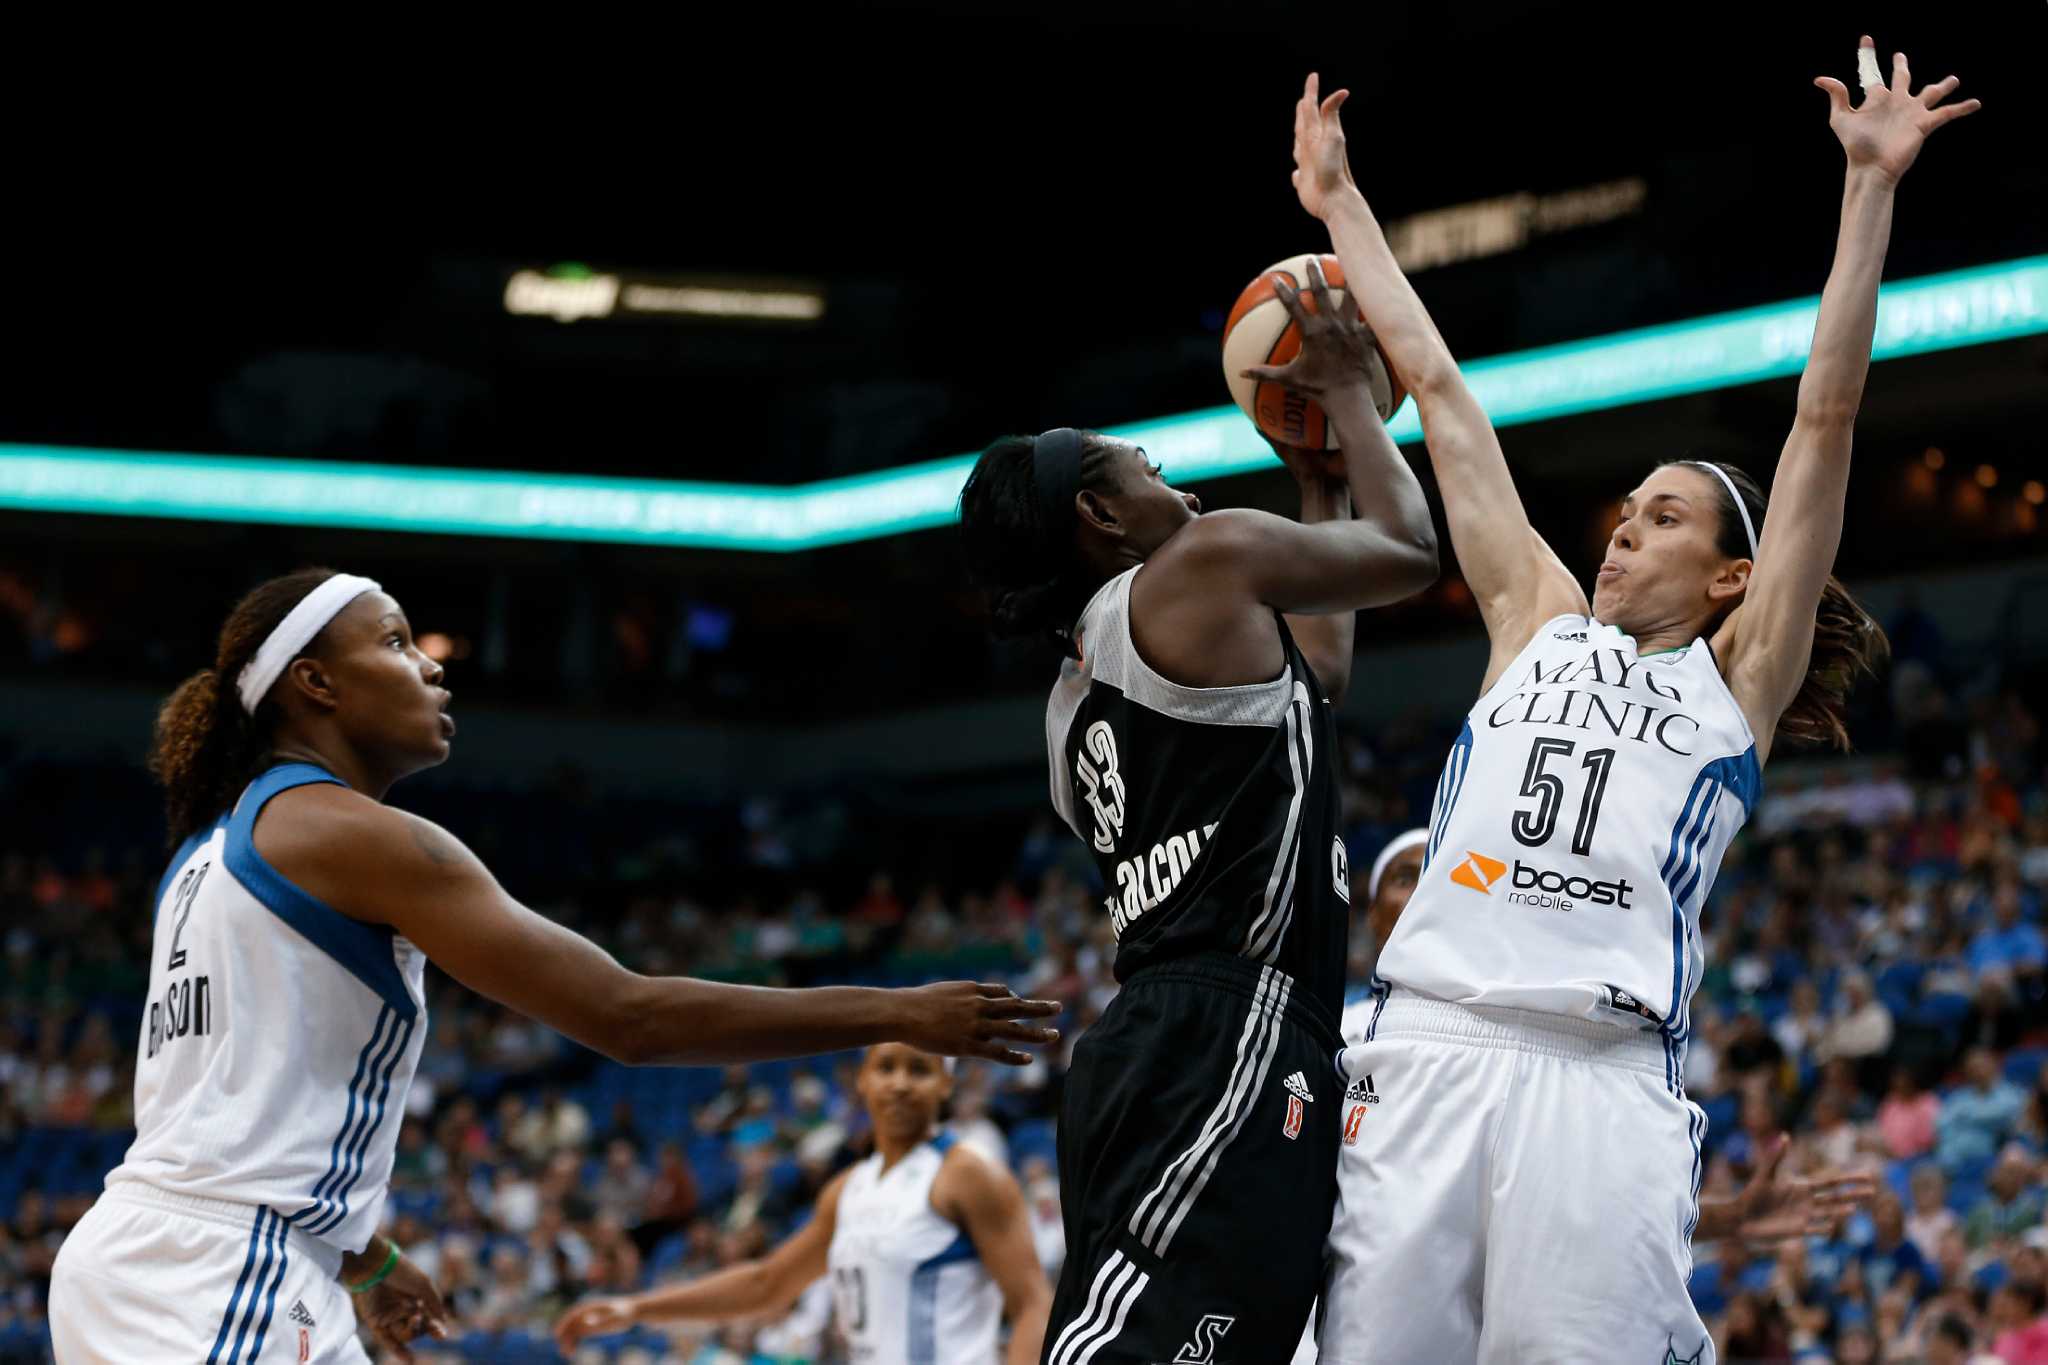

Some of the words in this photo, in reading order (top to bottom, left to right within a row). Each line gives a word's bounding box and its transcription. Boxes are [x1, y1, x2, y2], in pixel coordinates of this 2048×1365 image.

[1488, 690, 1700, 756] CLINIC
[1077, 720, 1126, 854] 33
[1512, 737, 1616, 857] 51
[1508, 892, 1573, 911] mobile
[1512, 860, 1633, 910] boost
[1283, 1078, 1314, 1102] adidas
[1346, 1090, 1380, 1104] adidas
